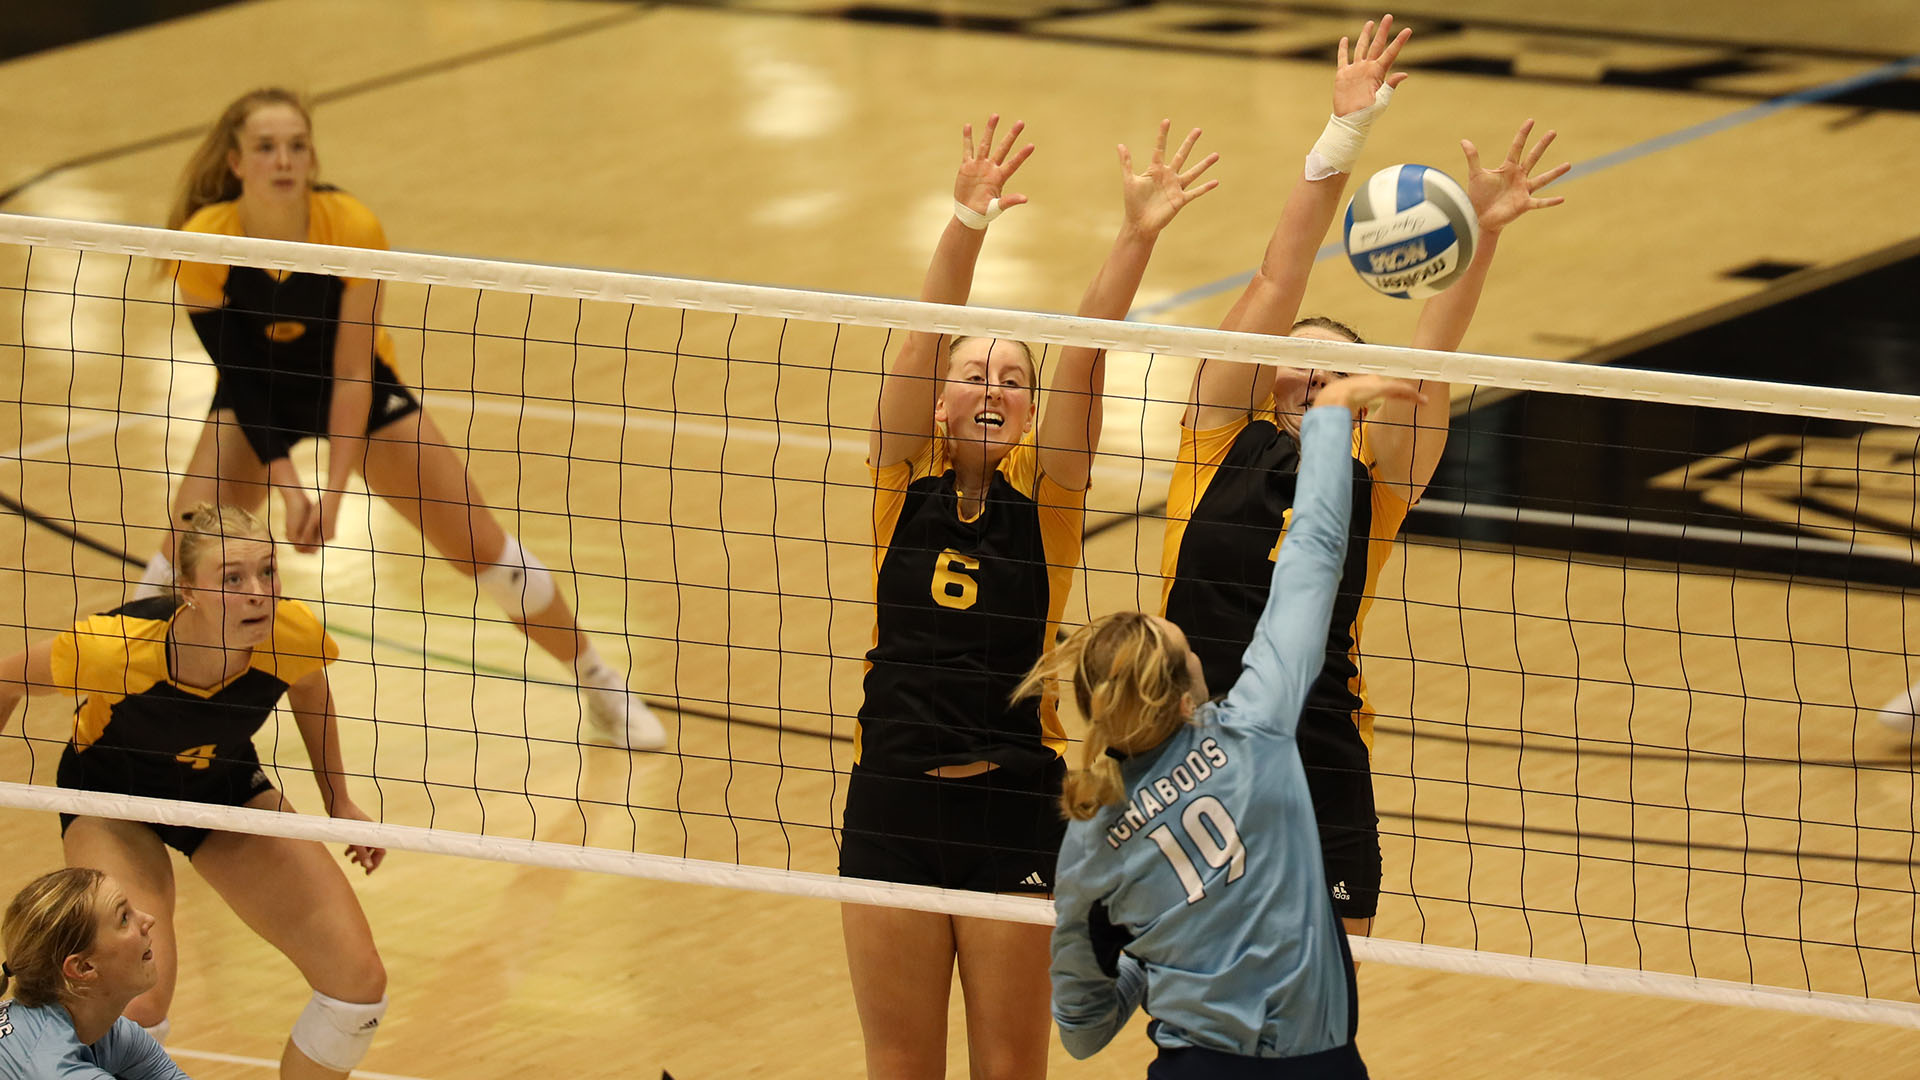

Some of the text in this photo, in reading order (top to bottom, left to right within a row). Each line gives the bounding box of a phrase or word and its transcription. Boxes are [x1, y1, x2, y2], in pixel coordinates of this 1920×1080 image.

[1369, 238, 1428, 274] NCAA
[1376, 258, 1446, 288] molten
[931, 548, 980, 610] 6
[176, 744, 217, 769] 4
[1107, 737, 1228, 849] ICHABODS
[1145, 794, 1247, 905] 19
